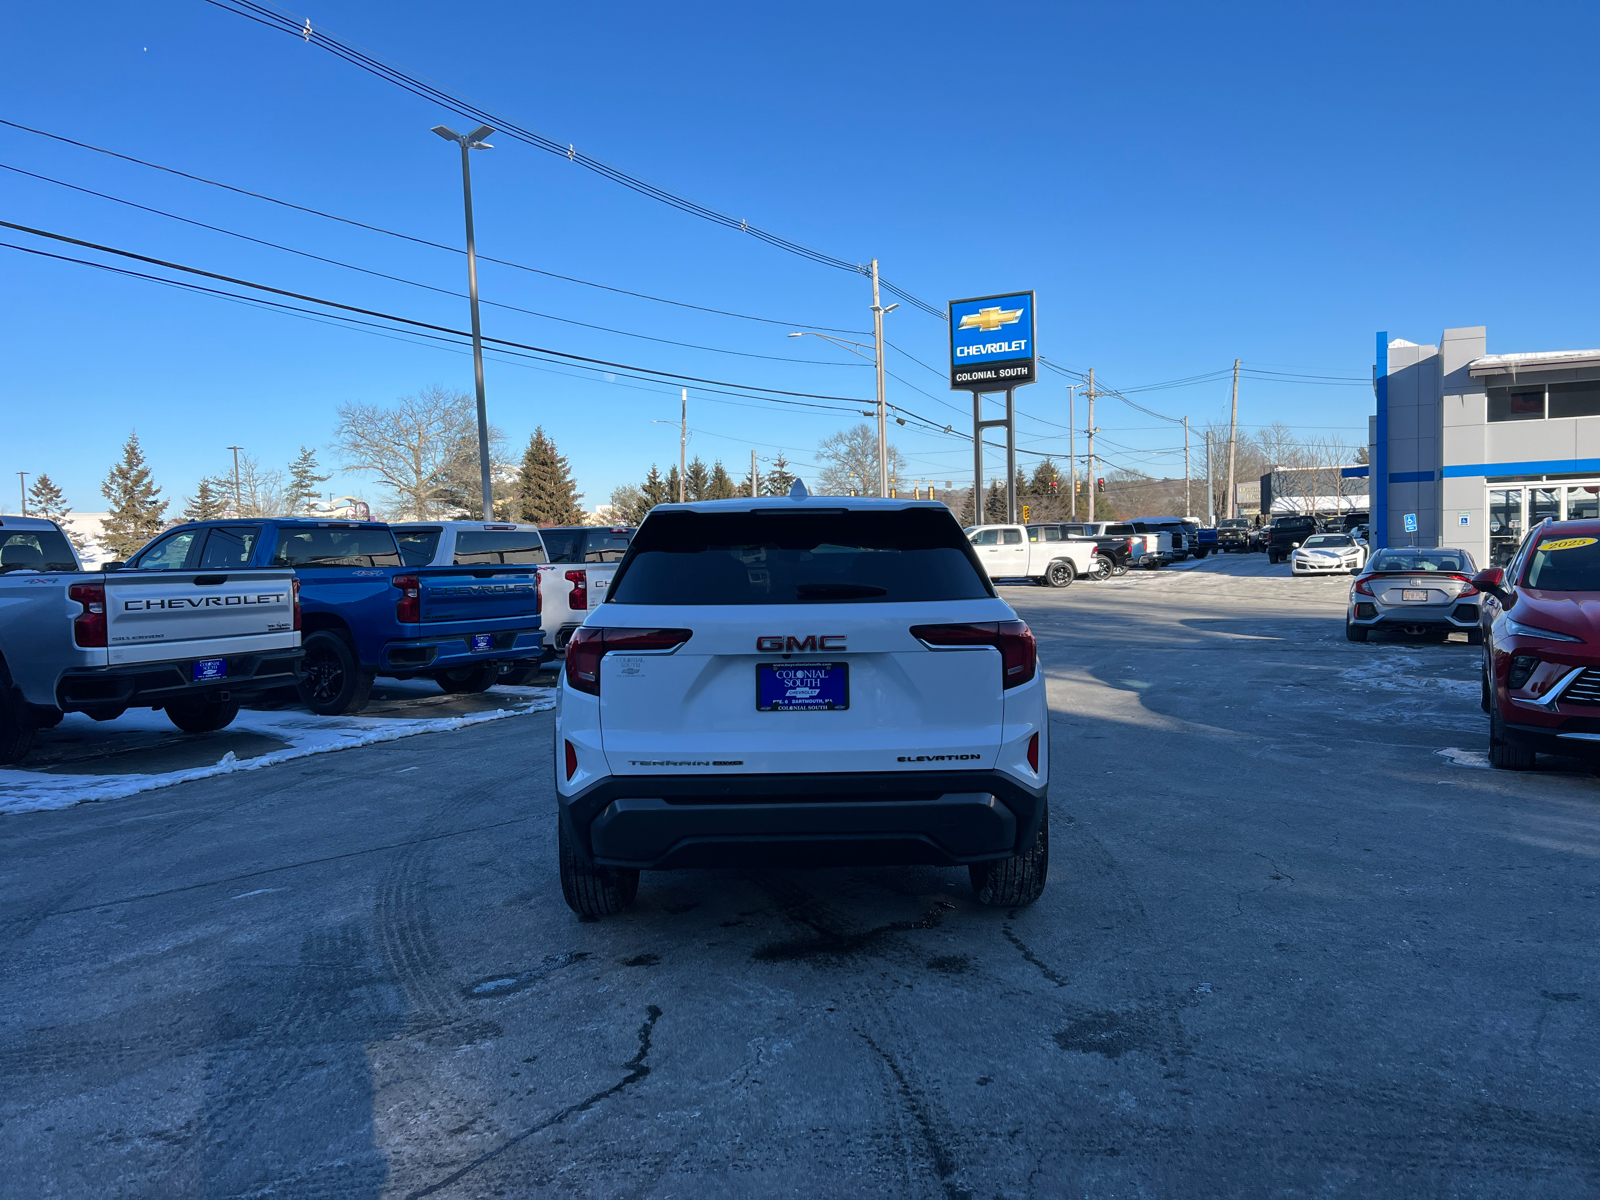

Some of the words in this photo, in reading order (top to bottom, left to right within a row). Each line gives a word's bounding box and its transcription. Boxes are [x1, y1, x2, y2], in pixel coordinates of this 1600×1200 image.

[956, 339, 1027, 357] CHEVROLET
[956, 370, 997, 381] COLONIAL
[999, 366, 1028, 377] SOUTH
[1548, 539, 1587, 550] 2025
[431, 583, 536, 596] CHEVROLET
[124, 593, 285, 611] CHEVROLET
[757, 635, 847, 652] GMC
[776, 669, 829, 679] COLONIAL
[784, 678, 821, 688] SOUTH
[897, 754, 981, 762] ELEVATION
